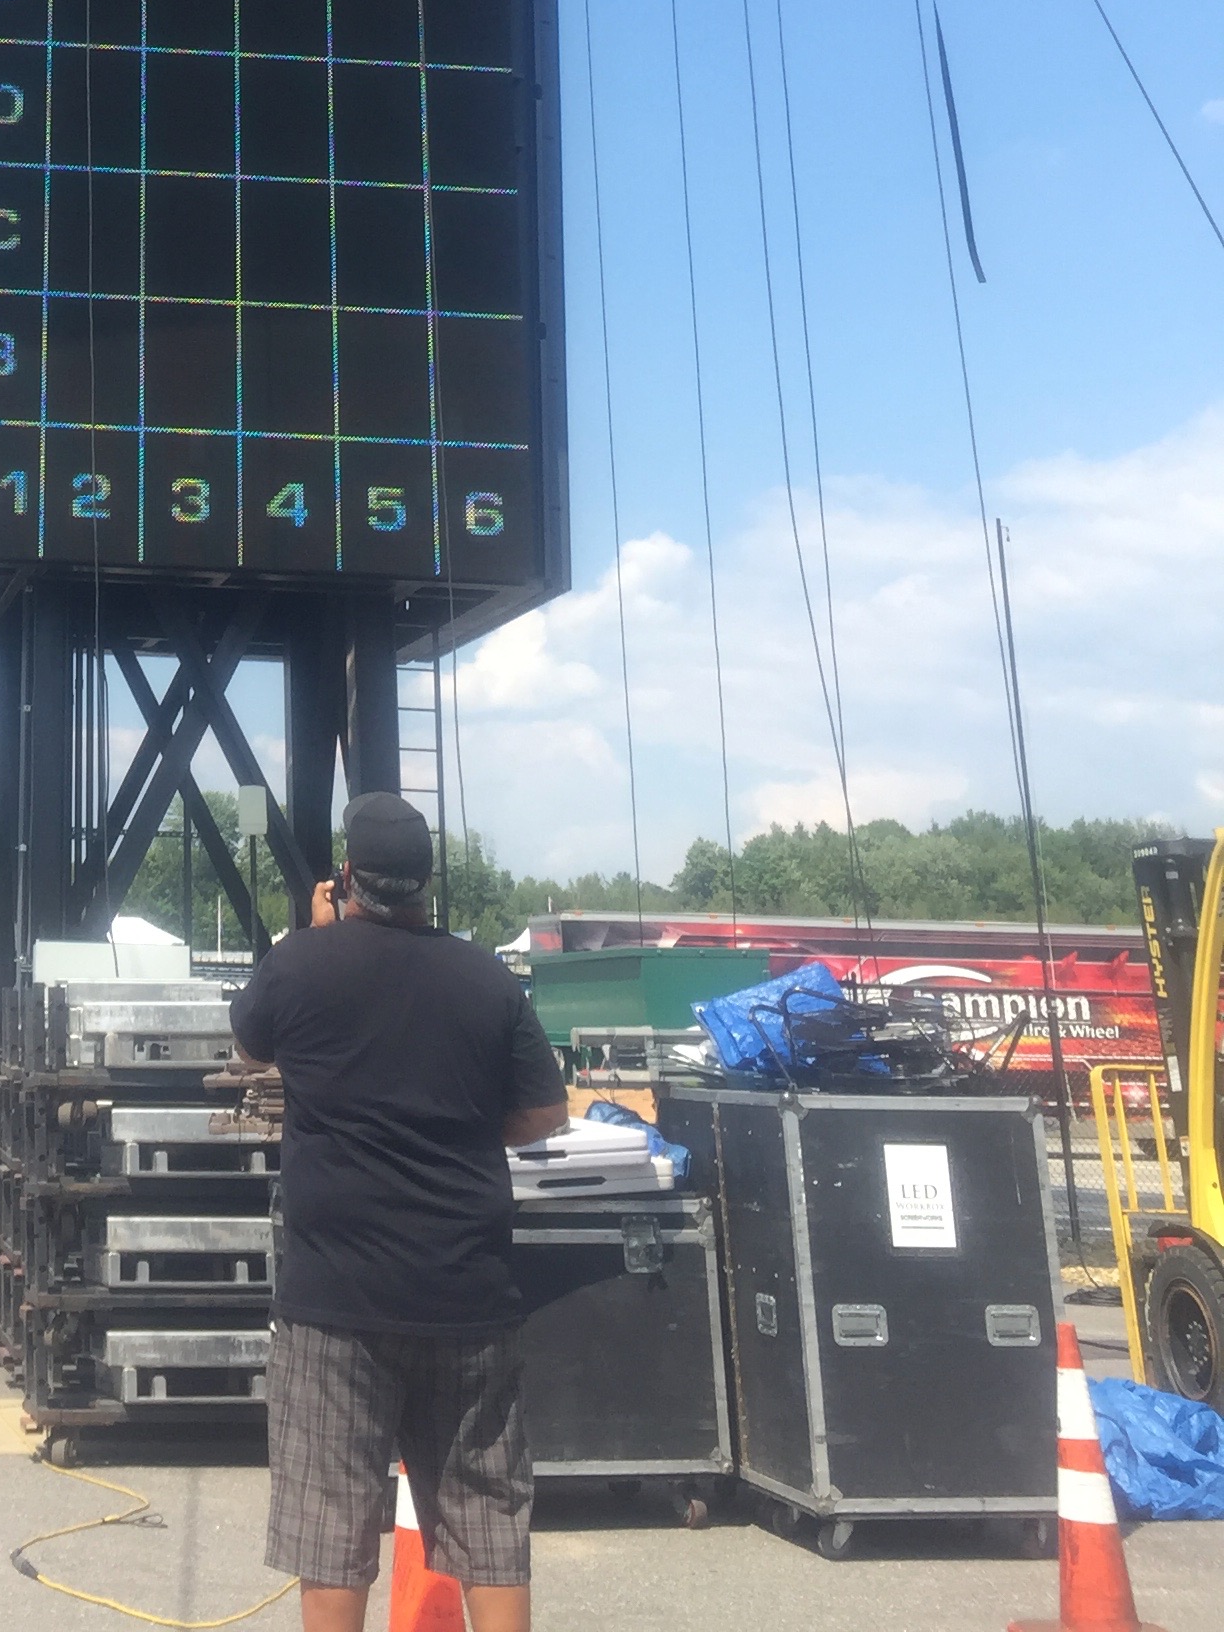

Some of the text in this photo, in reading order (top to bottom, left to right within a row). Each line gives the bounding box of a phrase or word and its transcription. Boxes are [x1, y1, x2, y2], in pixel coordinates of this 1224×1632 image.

[71, 473, 111, 520] 2
[171, 477, 211, 524] 3
[266, 481, 309, 529] 4
[367, 486, 408, 533] 5
[464, 490, 505, 537] 6
[1140, 884, 1168, 999] HYSTER
[1069, 1024, 1120, 1039] Wheel
[901, 1184, 938, 1199] LED
[895, 1201, 945, 1211] WORKBOX
